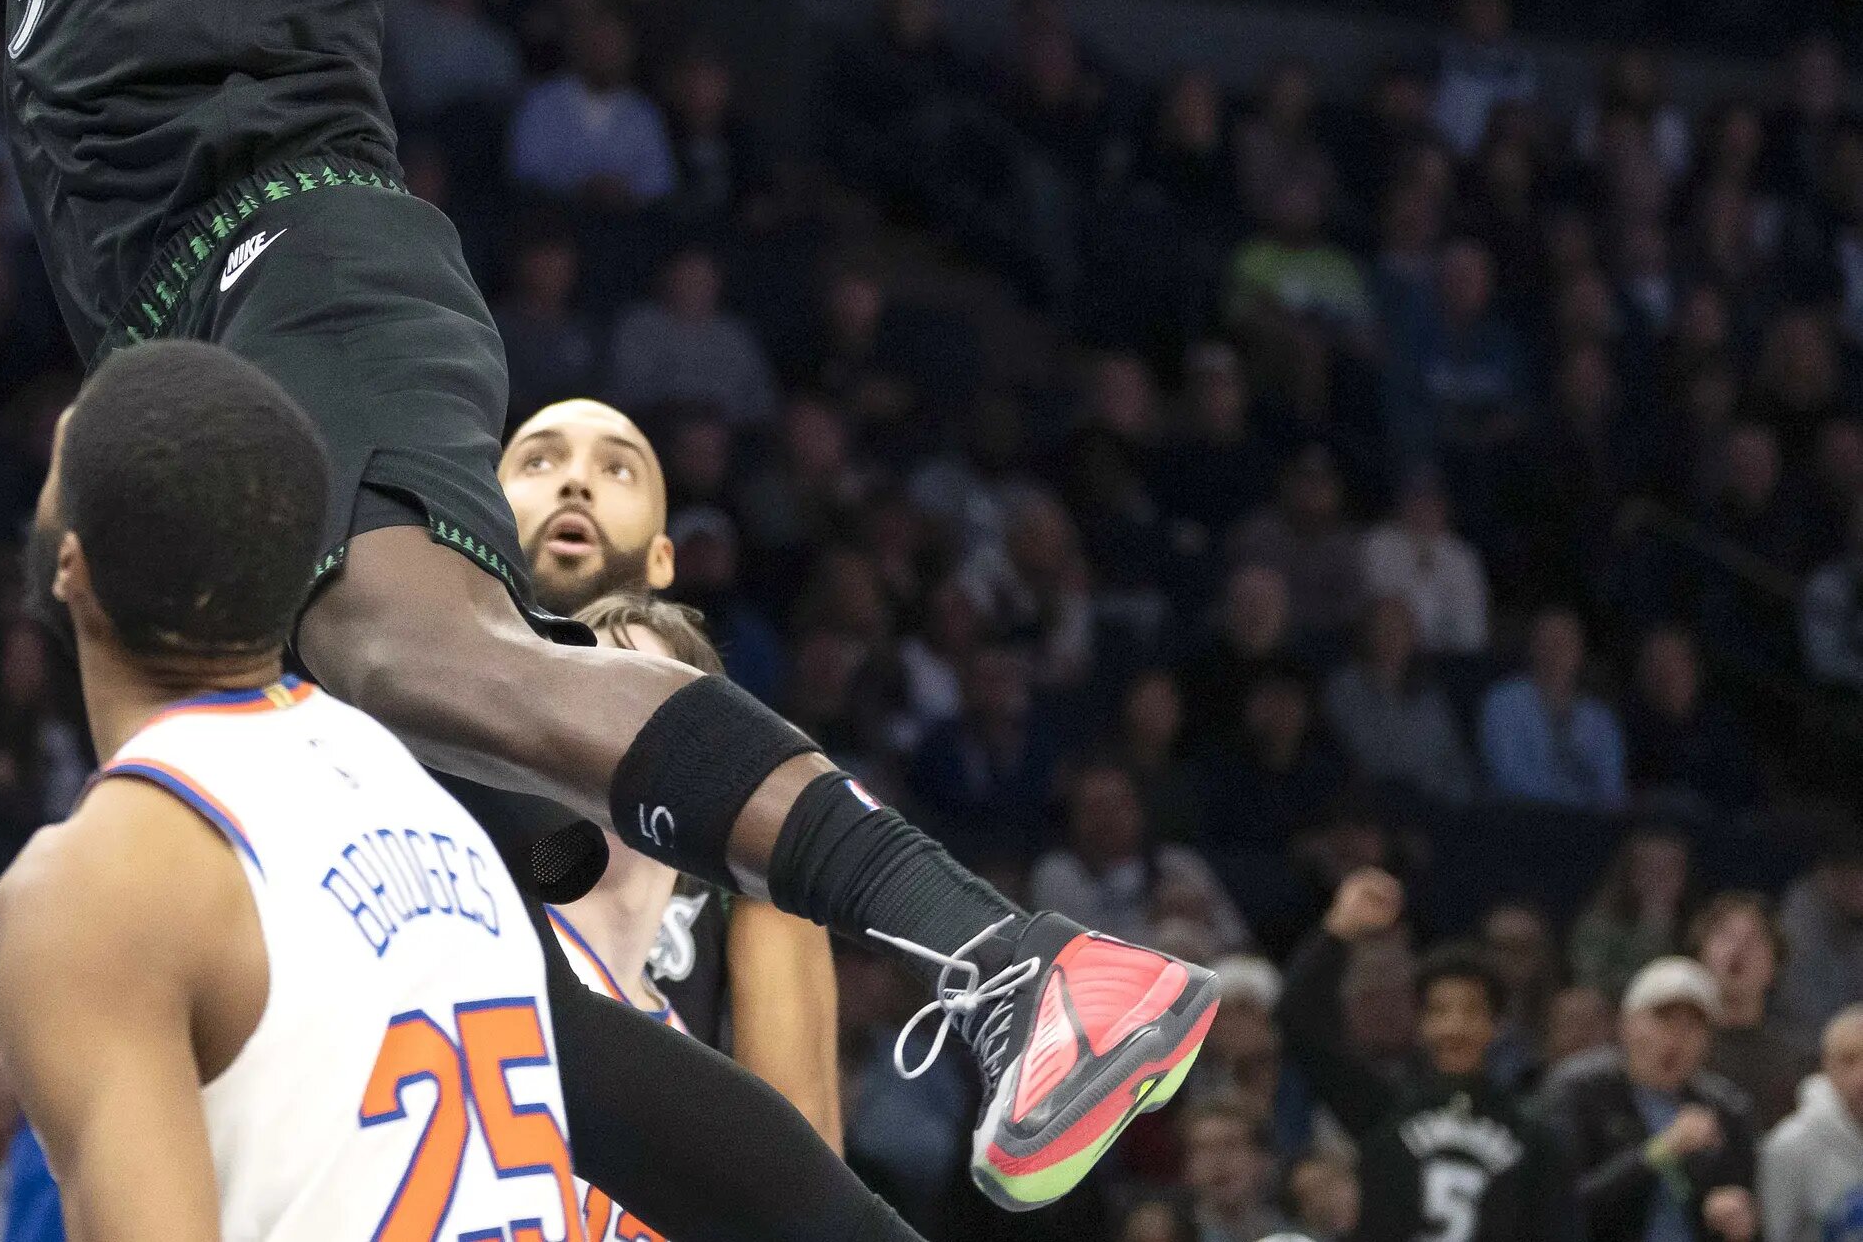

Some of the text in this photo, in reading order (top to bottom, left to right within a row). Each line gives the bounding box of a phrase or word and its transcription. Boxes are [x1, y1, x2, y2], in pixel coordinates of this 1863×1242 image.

[226, 230, 267, 275] NIKE
[321, 828, 500, 958] BRIDGES
[358, 996, 584, 1242] 25
